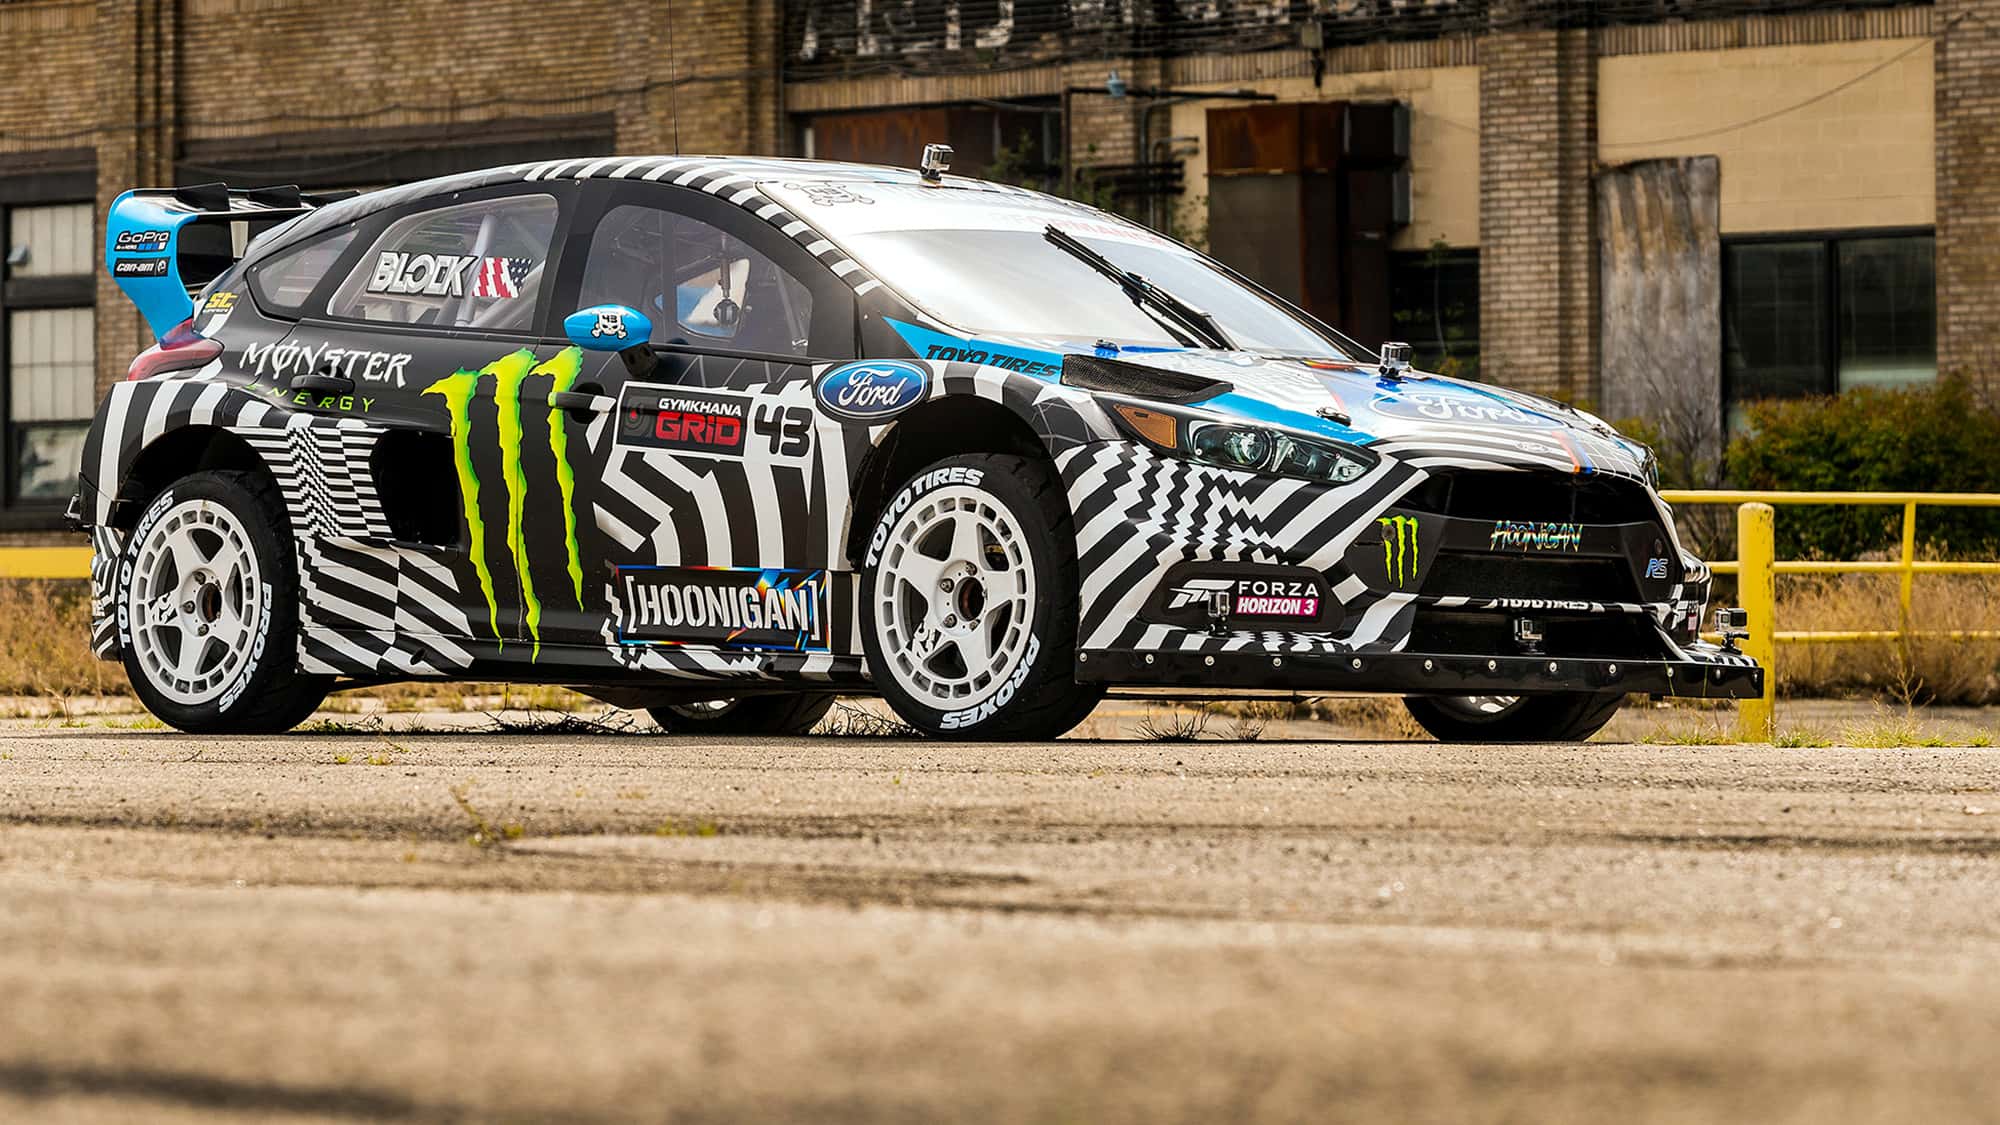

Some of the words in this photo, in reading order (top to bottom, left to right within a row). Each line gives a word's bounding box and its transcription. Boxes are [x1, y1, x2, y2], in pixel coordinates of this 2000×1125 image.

[117, 231, 170, 243] GoPro
[367, 251, 478, 297] BLOCK
[601, 314, 618, 323] 43
[925, 344, 985, 364] TOYO
[988, 354, 1061, 377] TIRES
[838, 368, 907, 409] Ford
[658, 398, 742, 417] GYMKHANA
[1409, 393, 1540, 425] Ford
[754, 403, 813, 458] 43
[864, 488, 913, 569] TOYO
[911, 467, 985, 497] TIRES
[117, 560, 133, 649] TOYO
[127, 490, 175, 558] TIRES
[1237, 597, 1300, 614] HORIZON
[1303, 599, 1316, 615] 3
[1238, 580, 1319, 597] FORZA
[217, 581, 273, 714] PROXES
[939, 632, 1041, 730] PROXES
